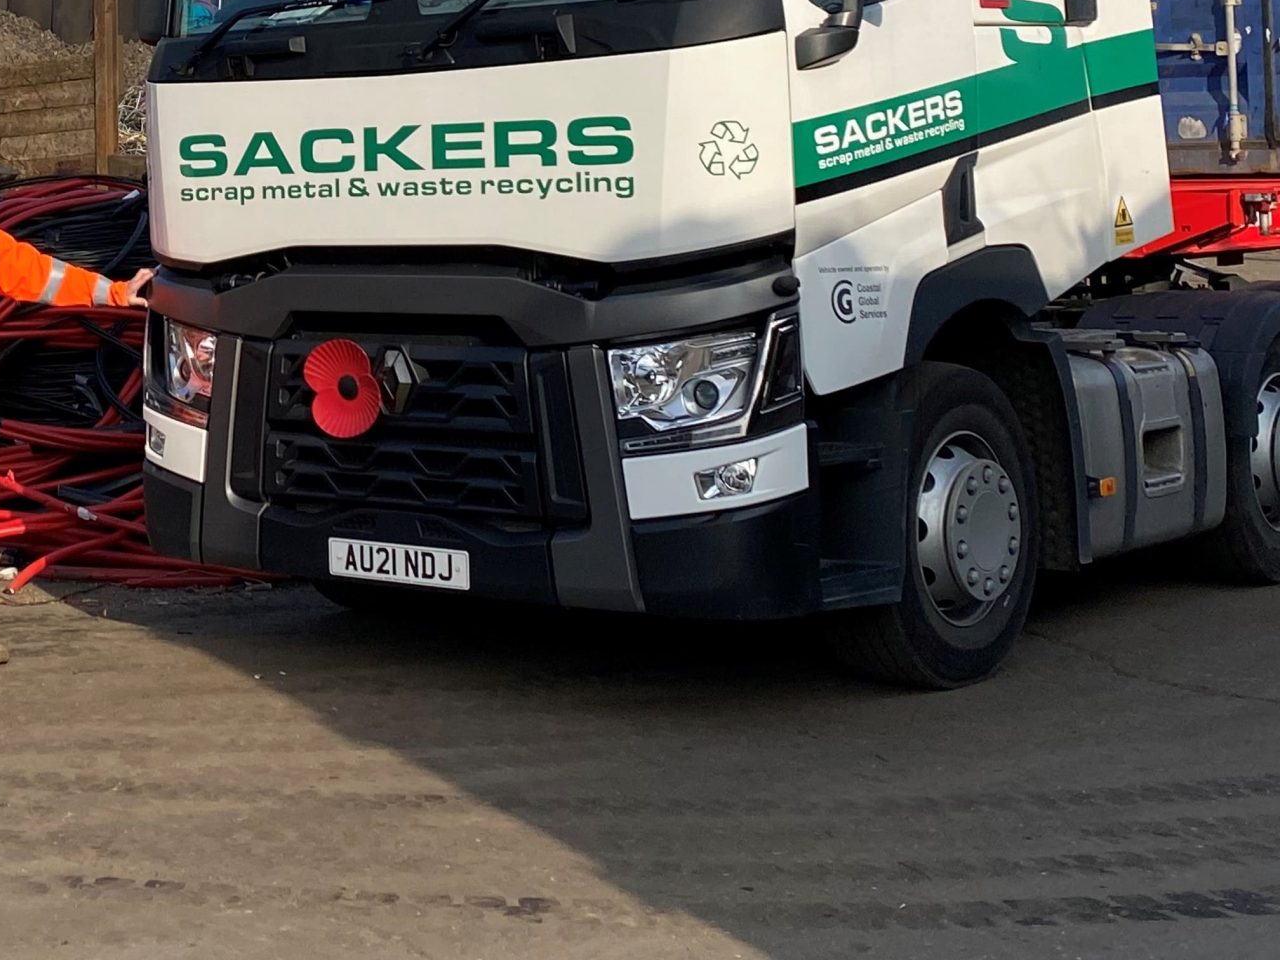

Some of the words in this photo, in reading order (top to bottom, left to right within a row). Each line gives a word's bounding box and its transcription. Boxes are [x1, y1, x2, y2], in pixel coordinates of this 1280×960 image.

[814, 90, 963, 154] SACKERS
[179, 116, 634, 178] SACKERS
[818, 151, 853, 169] scrap
[854, 140, 884, 160] metal
[885, 137, 894, 150] &
[894, 128, 924, 147] waste
[925, 119, 965, 138] recycling
[180, 183, 255, 205] scrap
[262, 178, 340, 199] metal
[348, 178, 369, 197] &
[377, 177, 472, 196] waste
[480, 172, 634, 199] recycling
[857, 283, 881, 292] Coastal
[858, 296, 880, 306] Global
[859, 310, 887, 319] Services
[344, 543, 397, 576] AU21
[404, 549, 453, 581] NDJ
